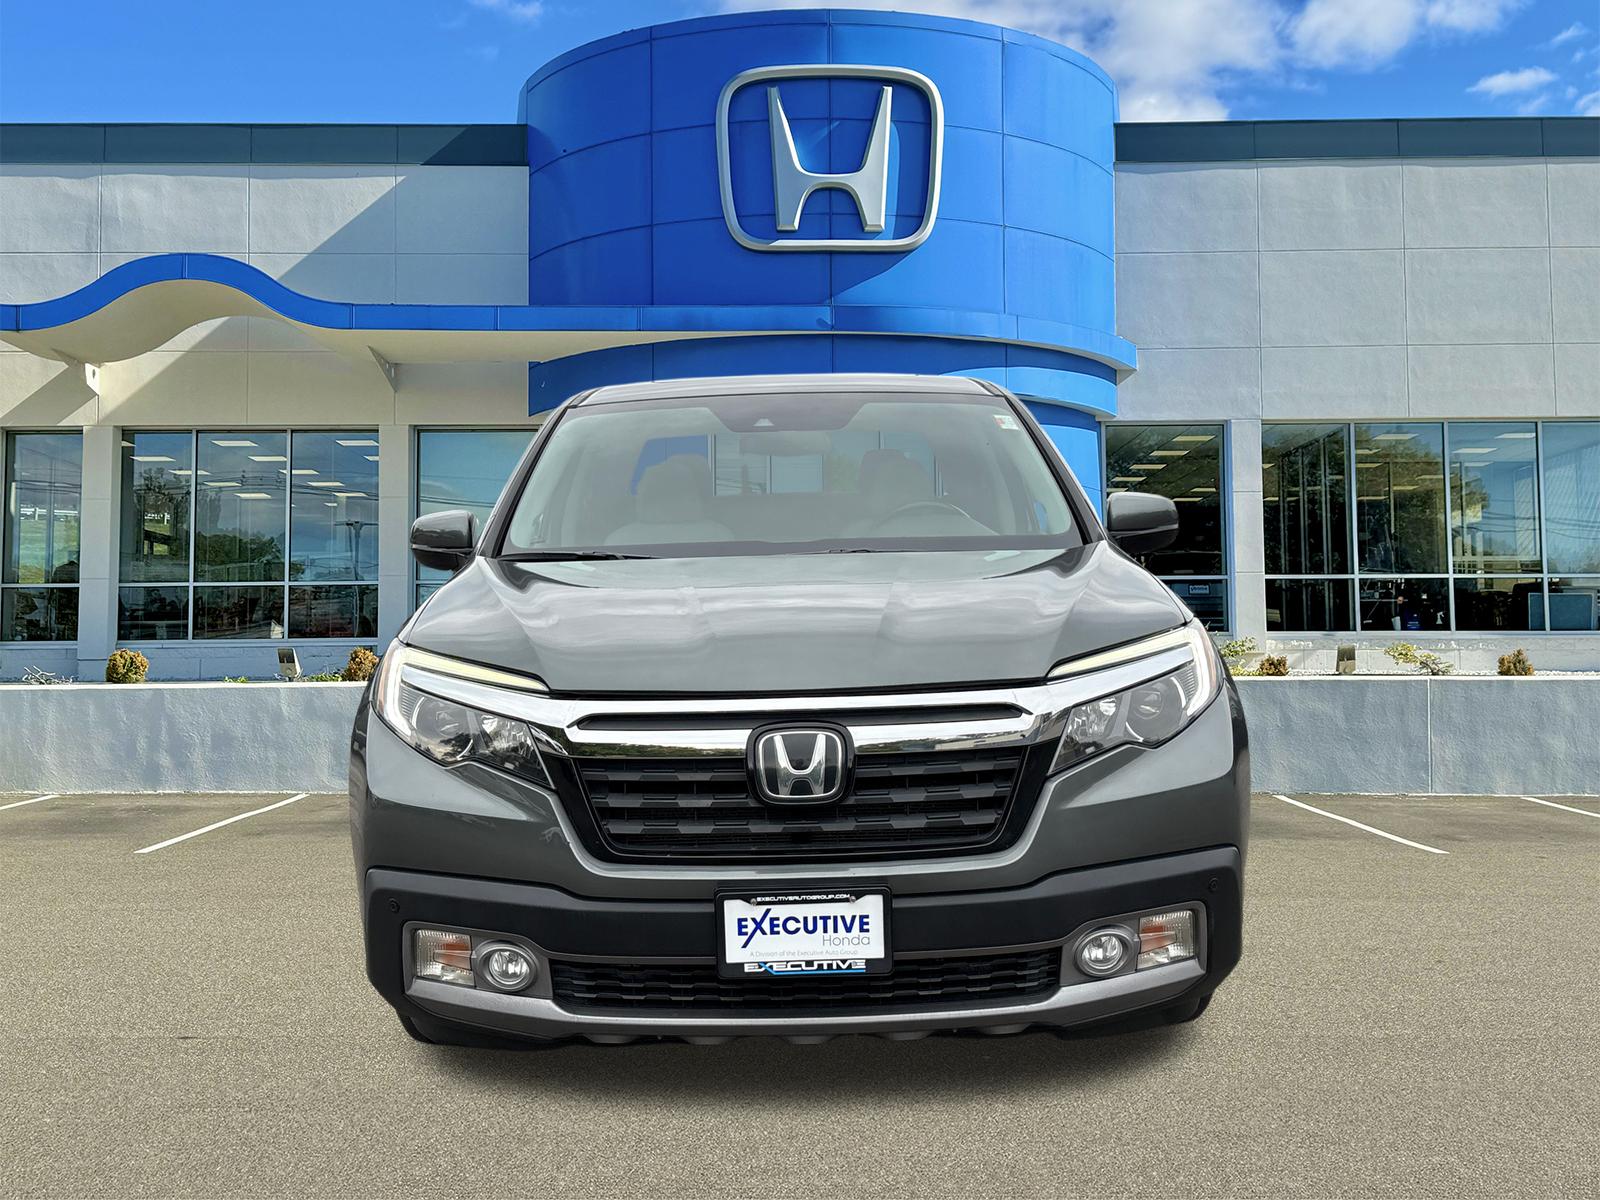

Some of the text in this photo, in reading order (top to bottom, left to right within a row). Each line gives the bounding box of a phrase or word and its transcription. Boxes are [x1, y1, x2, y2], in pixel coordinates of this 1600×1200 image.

[737, 908, 870, 949] EXECUTIVE
[822, 934, 871, 947] Honda
[743, 959, 866, 974] EXECUTIVE
